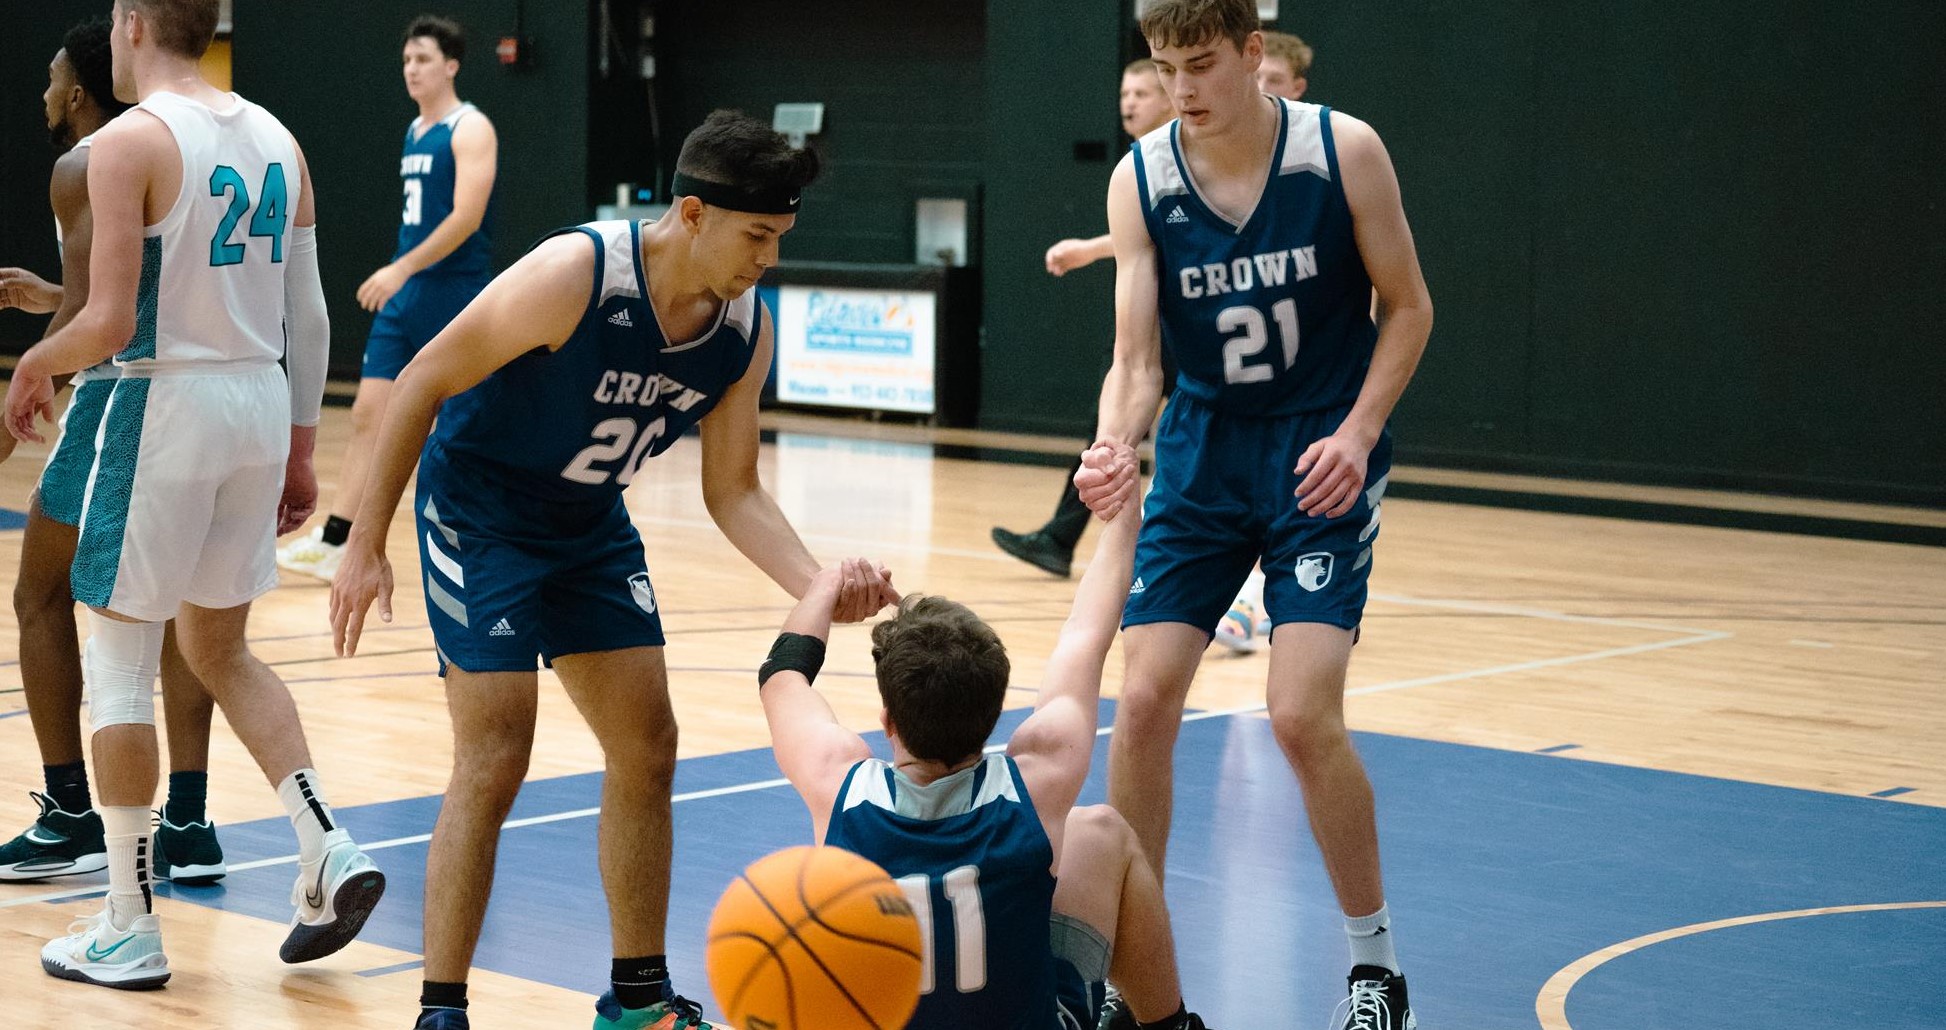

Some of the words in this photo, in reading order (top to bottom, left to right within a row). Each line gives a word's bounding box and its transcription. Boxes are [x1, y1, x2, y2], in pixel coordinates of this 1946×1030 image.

[209, 163, 287, 266] 24
[1179, 244, 1318, 299] CROWN
[608, 317, 632, 327] adidas
[1215, 298, 1300, 385] 21
[488, 629, 516, 637] adidas
